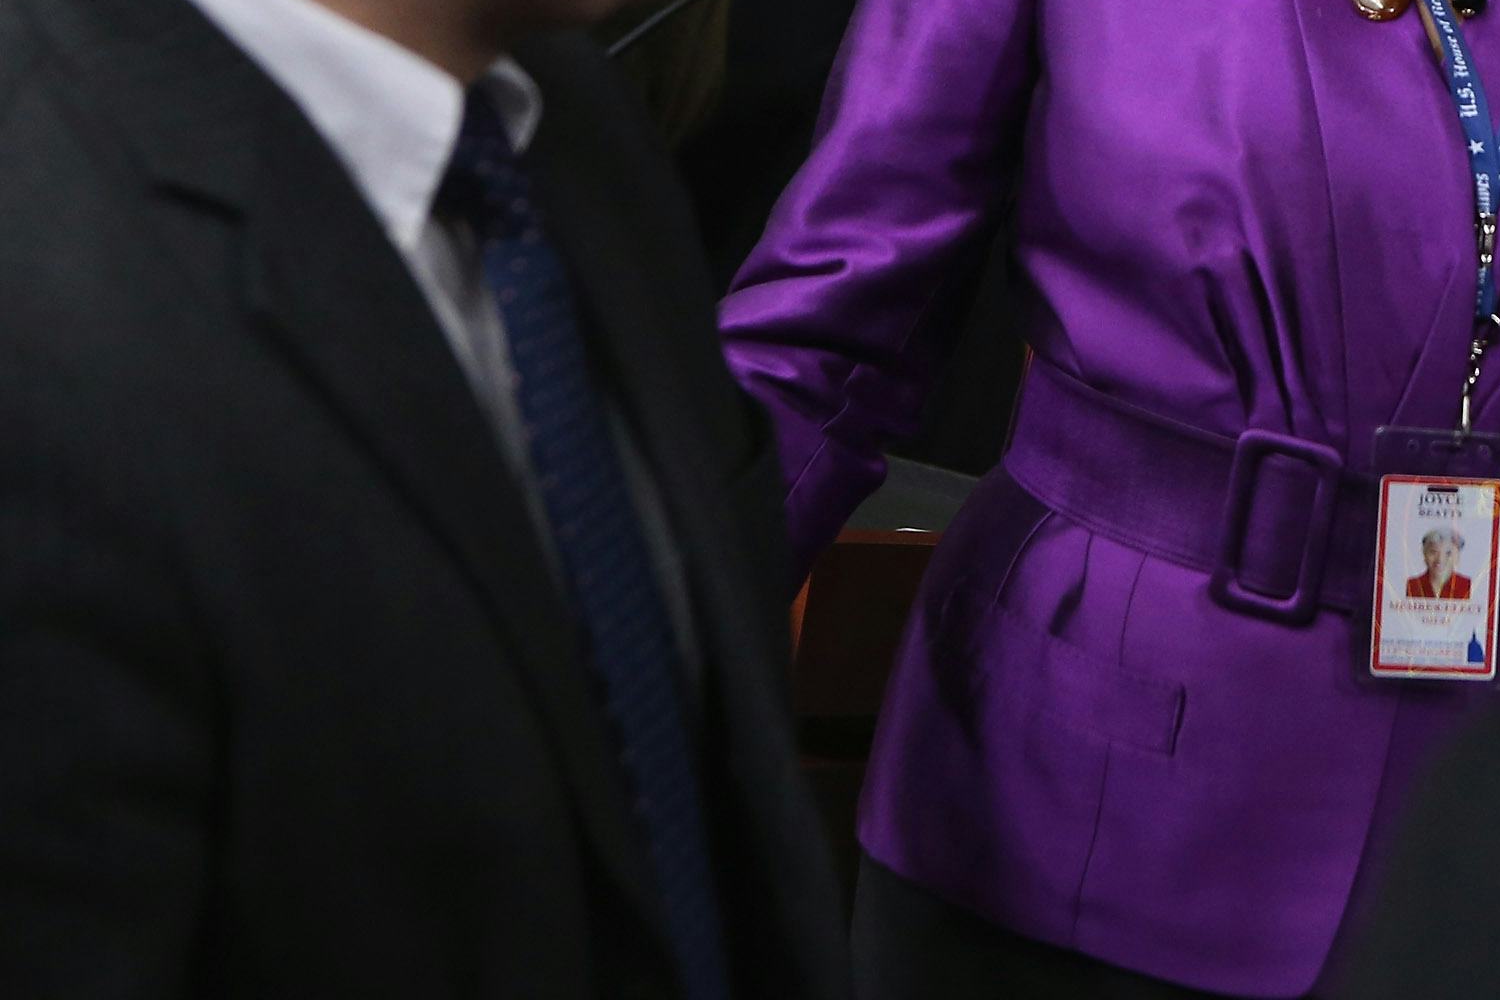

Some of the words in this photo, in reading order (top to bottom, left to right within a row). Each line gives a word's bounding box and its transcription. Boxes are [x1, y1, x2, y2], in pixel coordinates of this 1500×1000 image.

[1439, 18, 1454, 35] of
[1447, 35, 1470, 78] House
[1457, 82, 1478, 118] U.S.
